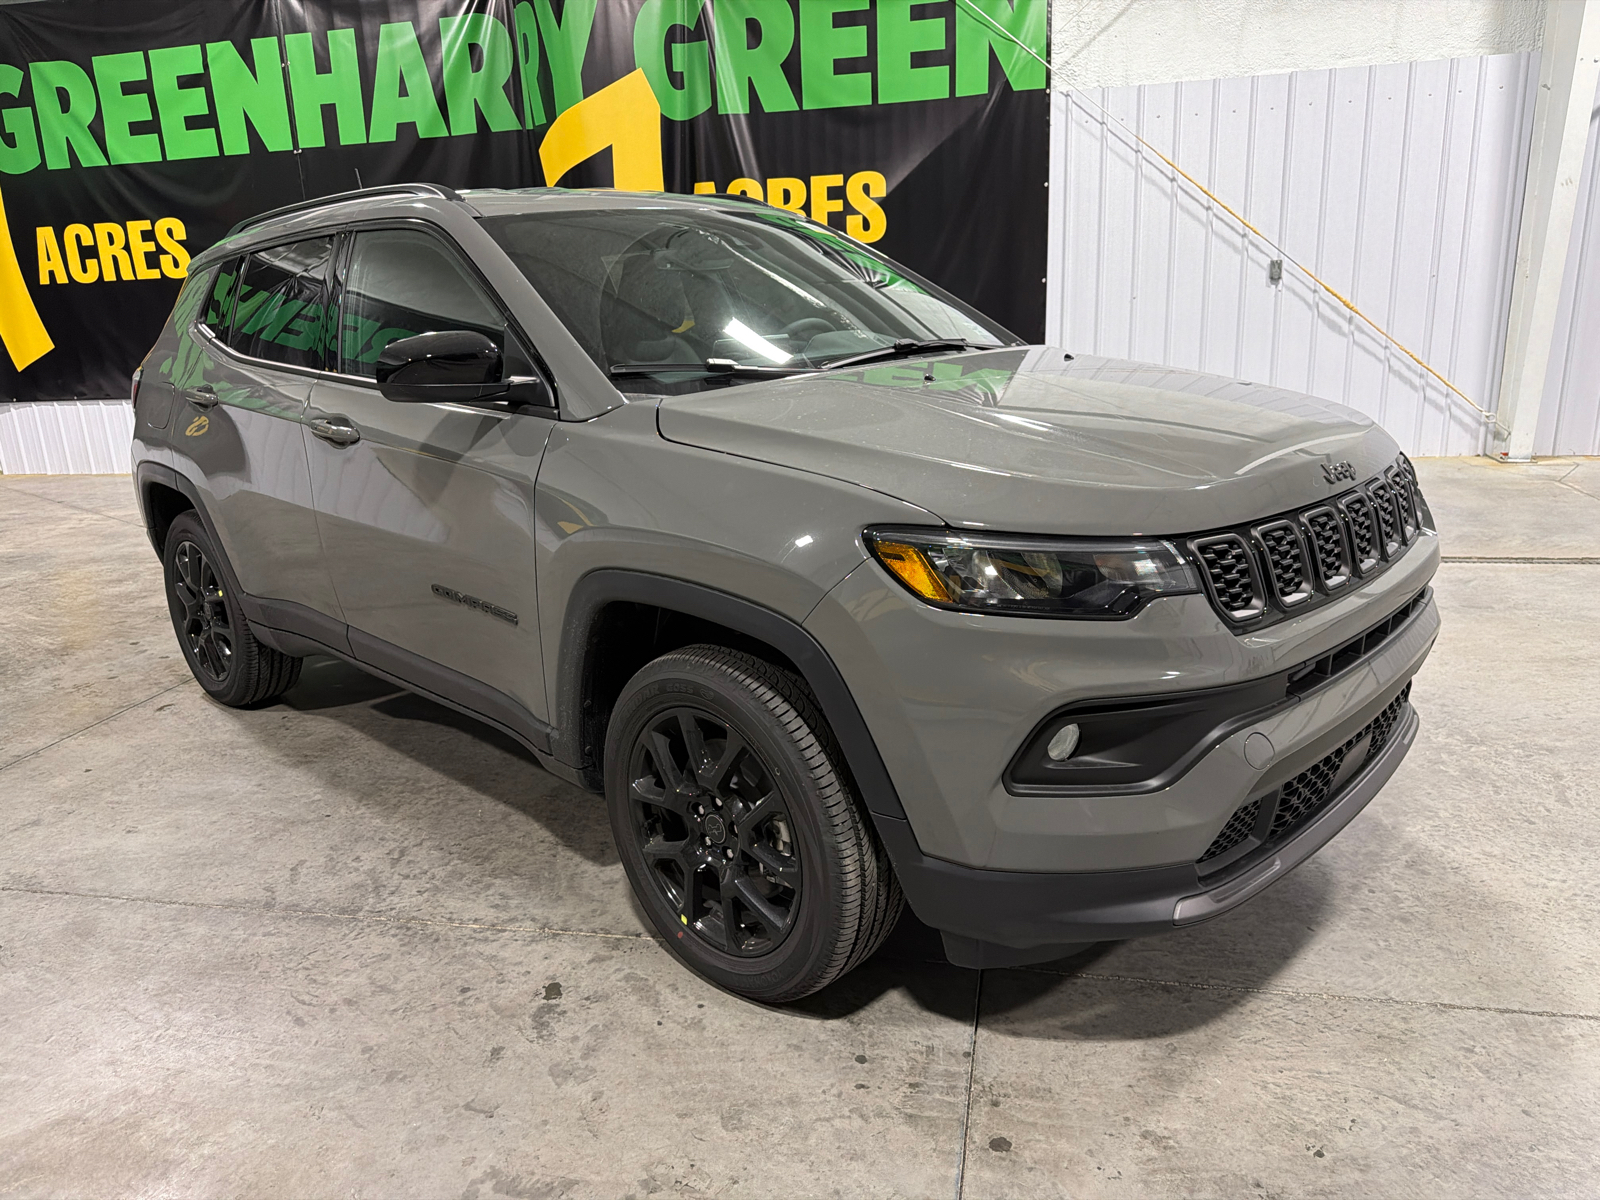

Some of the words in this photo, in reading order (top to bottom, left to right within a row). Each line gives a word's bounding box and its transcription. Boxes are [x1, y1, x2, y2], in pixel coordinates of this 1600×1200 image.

[633, 0, 1047, 122] GREEN
[693, 170, 887, 244] RES
[36, 217, 191, 285] ACRES
[1320, 460, 1357, 484] Jeep
